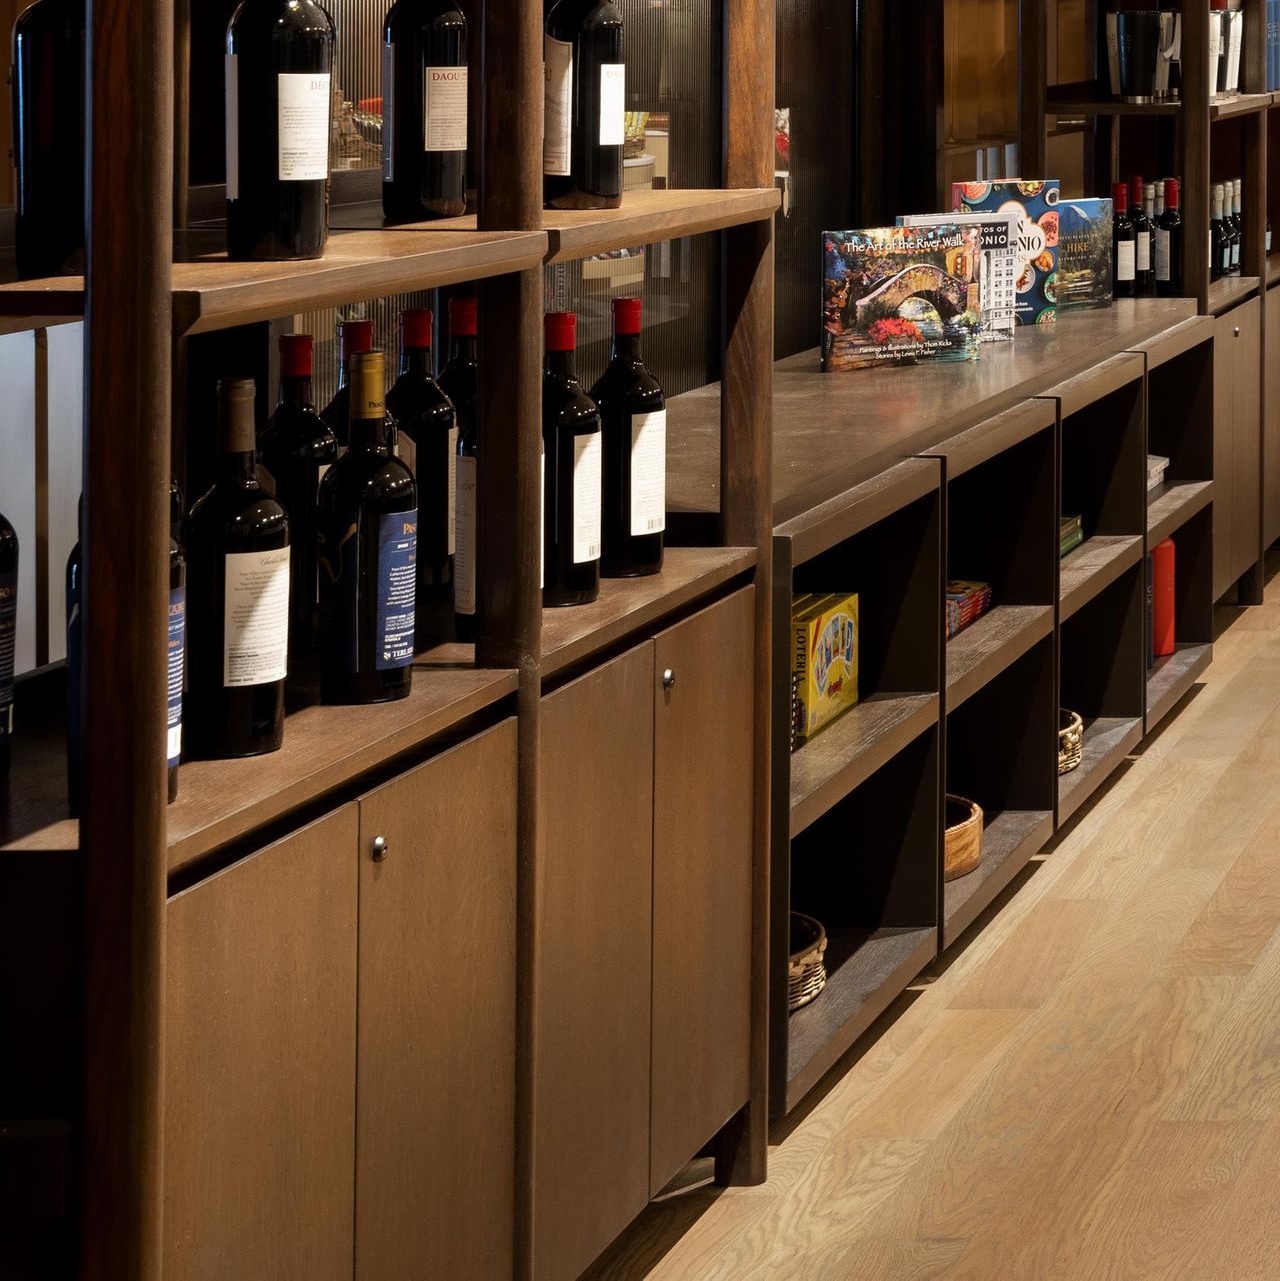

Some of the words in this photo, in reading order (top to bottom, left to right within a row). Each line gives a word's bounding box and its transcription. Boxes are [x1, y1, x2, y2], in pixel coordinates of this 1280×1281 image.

[432, 72, 460, 81] DAOU
[997, 225, 1007, 233] OF
[845, 239, 865, 252] The
[865, 242, 884, 251] Art
[884, 240, 898, 250] of
[898, 239, 915, 249] the
[916, 238, 941, 249] River
[941, 233, 966, 247] Walk
[1066, 242, 1089, 253] HIKE
[859, 346, 882, 354] Paintings
[887, 342, 917, 351] Illustrations
[916, 341, 924, 349] by
[894, 351, 901, 360] by
[796, 626, 807, 683] LOTERIA
